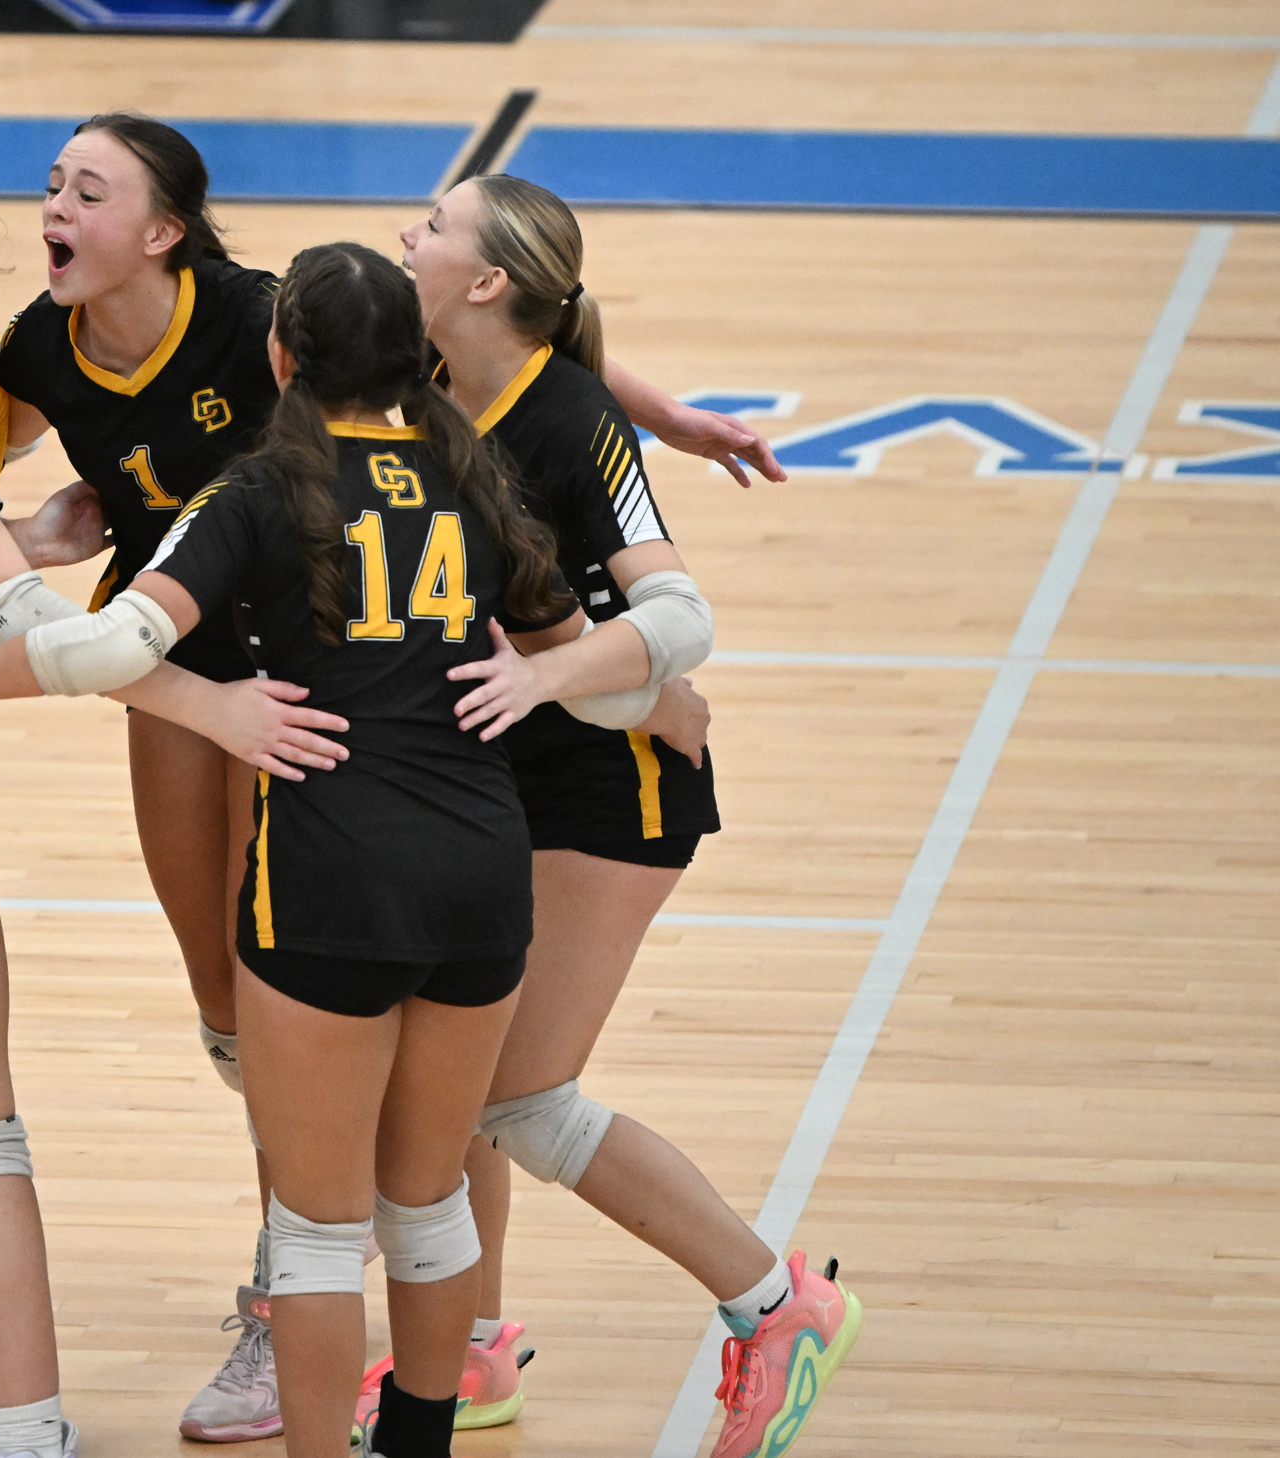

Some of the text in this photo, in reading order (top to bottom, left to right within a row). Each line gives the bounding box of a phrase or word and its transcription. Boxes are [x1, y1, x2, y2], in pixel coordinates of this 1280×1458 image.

[192, 387, 233, 434] CD
[119, 444, 183, 510] 1
[367, 452, 427, 508] CD
[344, 509, 476, 643] 14
